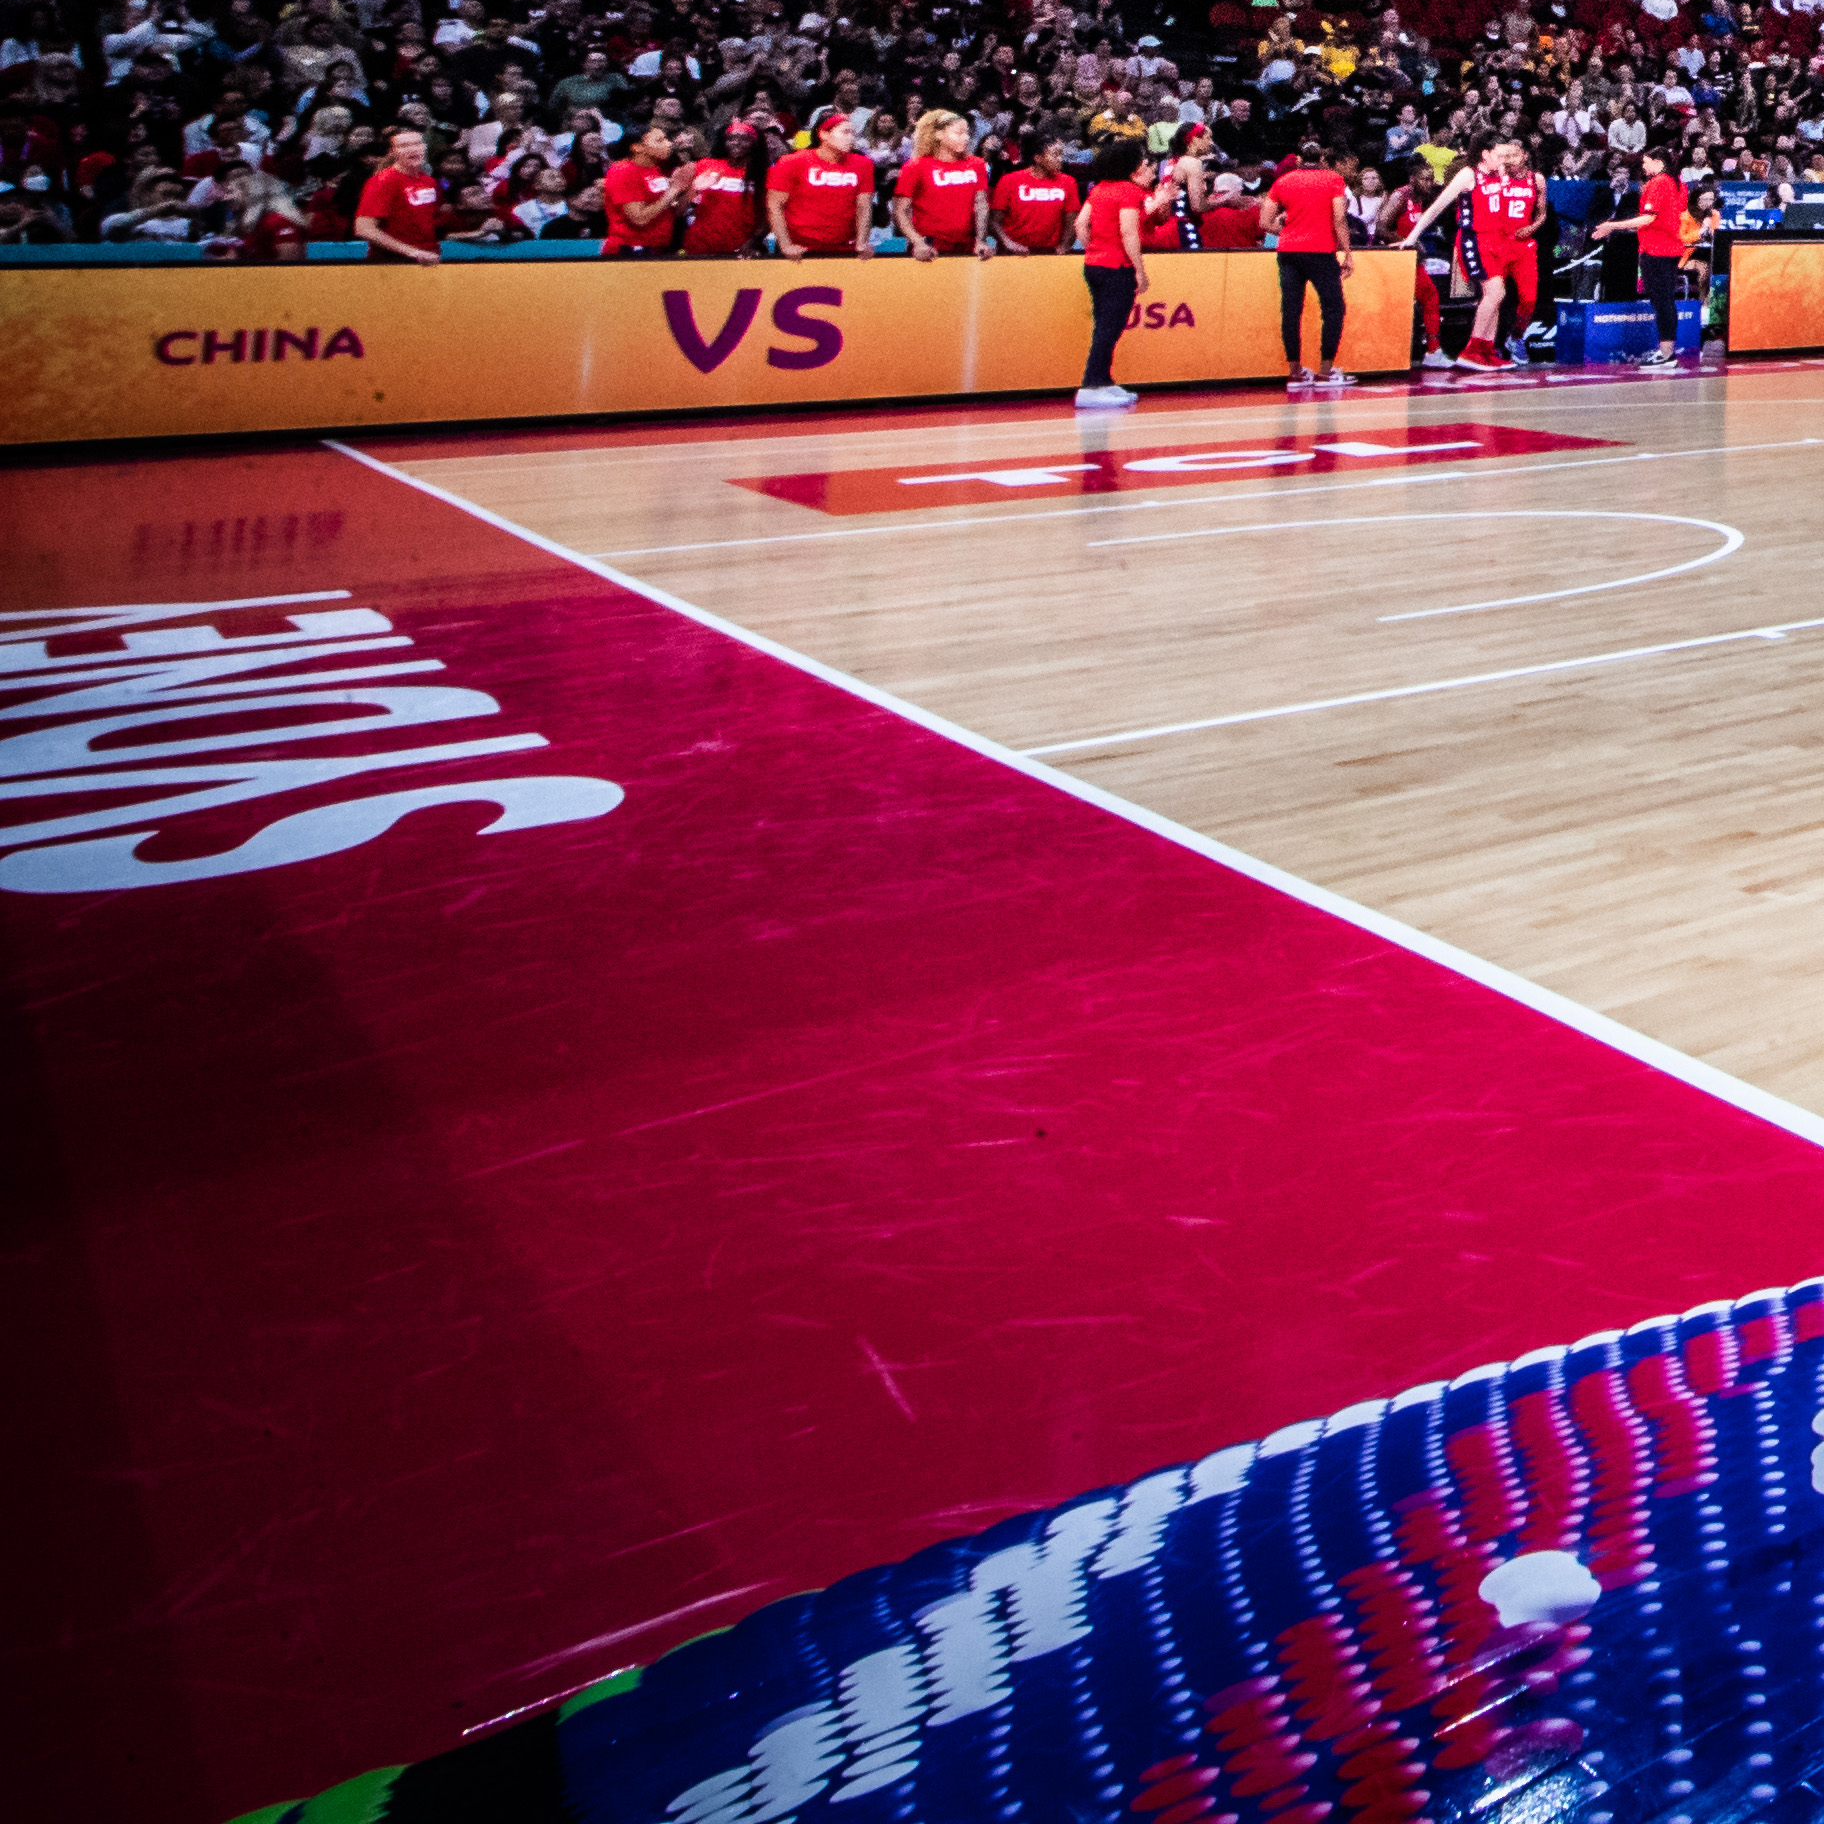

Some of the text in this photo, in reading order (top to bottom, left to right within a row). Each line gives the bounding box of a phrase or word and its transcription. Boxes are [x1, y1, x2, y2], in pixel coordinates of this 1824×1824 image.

[808, 168, 857, 187] USA
[933, 169, 977, 186] USA
[1019, 184, 1065, 202] USA
[1508, 199, 1526, 219] 12
[153, 326, 365, 366] CHINA
[661, 286, 844, 374] VS
[898, 440, 1483, 487] TCL
